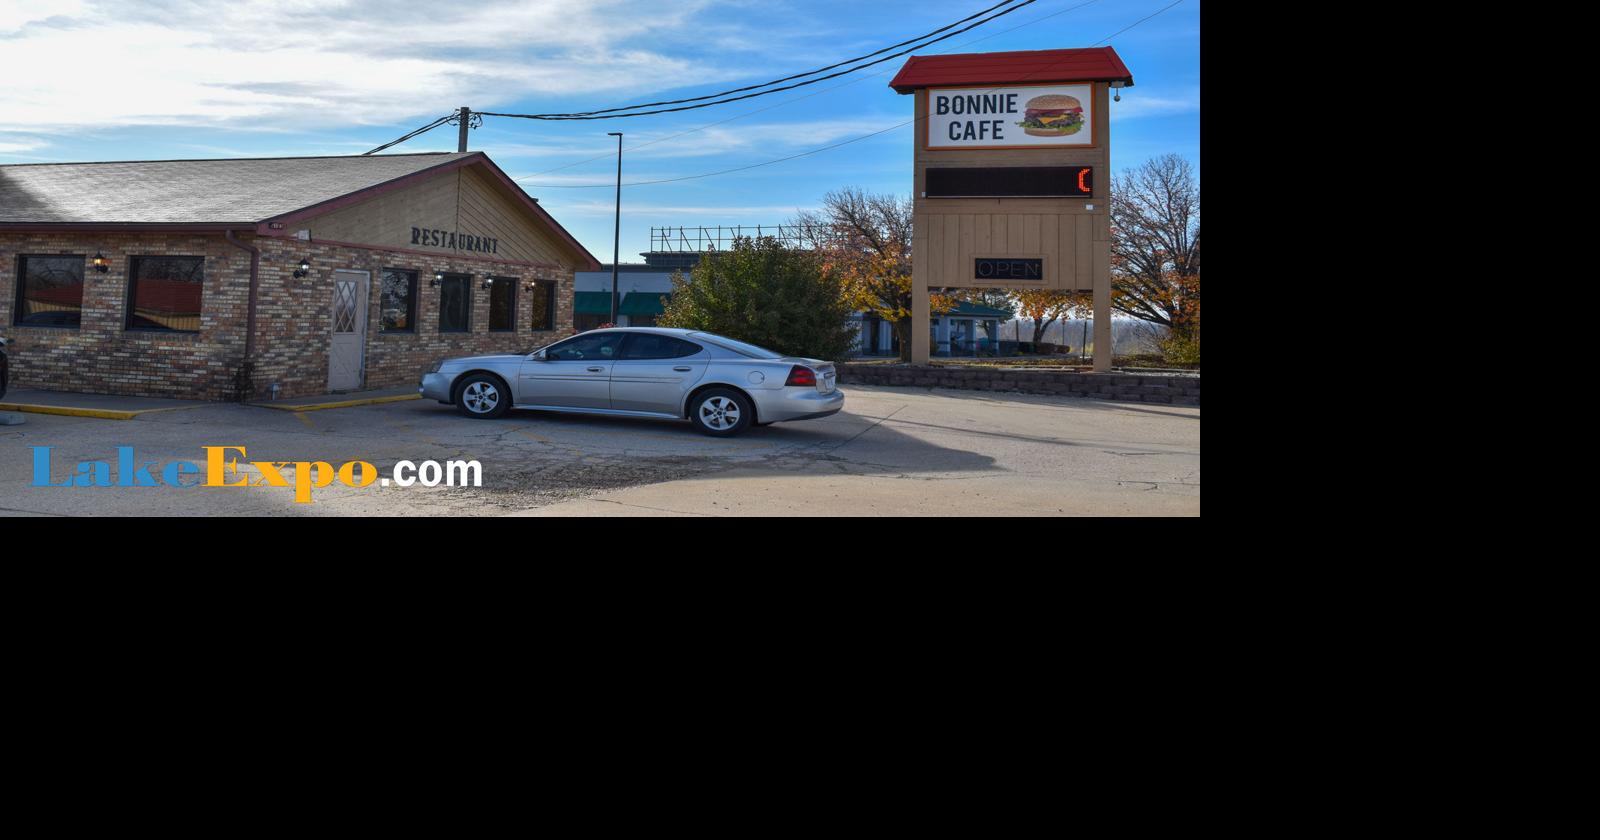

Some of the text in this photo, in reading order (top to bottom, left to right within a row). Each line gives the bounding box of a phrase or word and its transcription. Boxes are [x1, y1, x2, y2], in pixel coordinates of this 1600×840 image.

[936, 93, 1018, 115] BONNIE
[949, 120, 1004, 141] CAFE
[411, 226, 498, 254] RESTAURANT
[978, 261, 1040, 277] OPEN
